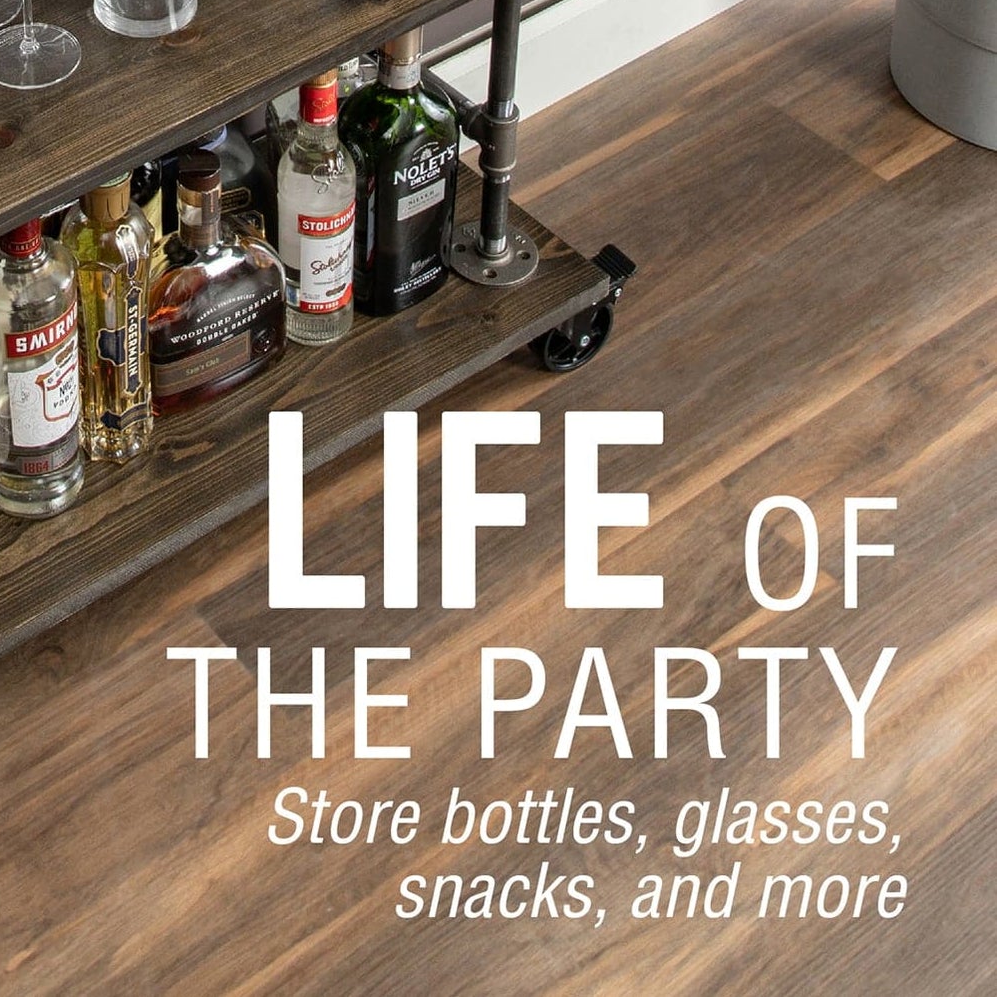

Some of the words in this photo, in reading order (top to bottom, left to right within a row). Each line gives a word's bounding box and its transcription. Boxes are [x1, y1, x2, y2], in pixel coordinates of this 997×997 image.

[393, 142, 457, 185] NOLET'S
[410, 174, 427, 187] DRY
[426, 167, 441, 180] GIN
[170, 316, 232, 345] WOODFORD
[234, 288, 280, 320] RESERVE
[196, 327, 229, 346] DOUBLE
[231, 312, 259, 331] OAKED
[23, 460, 49, 474] 1864
